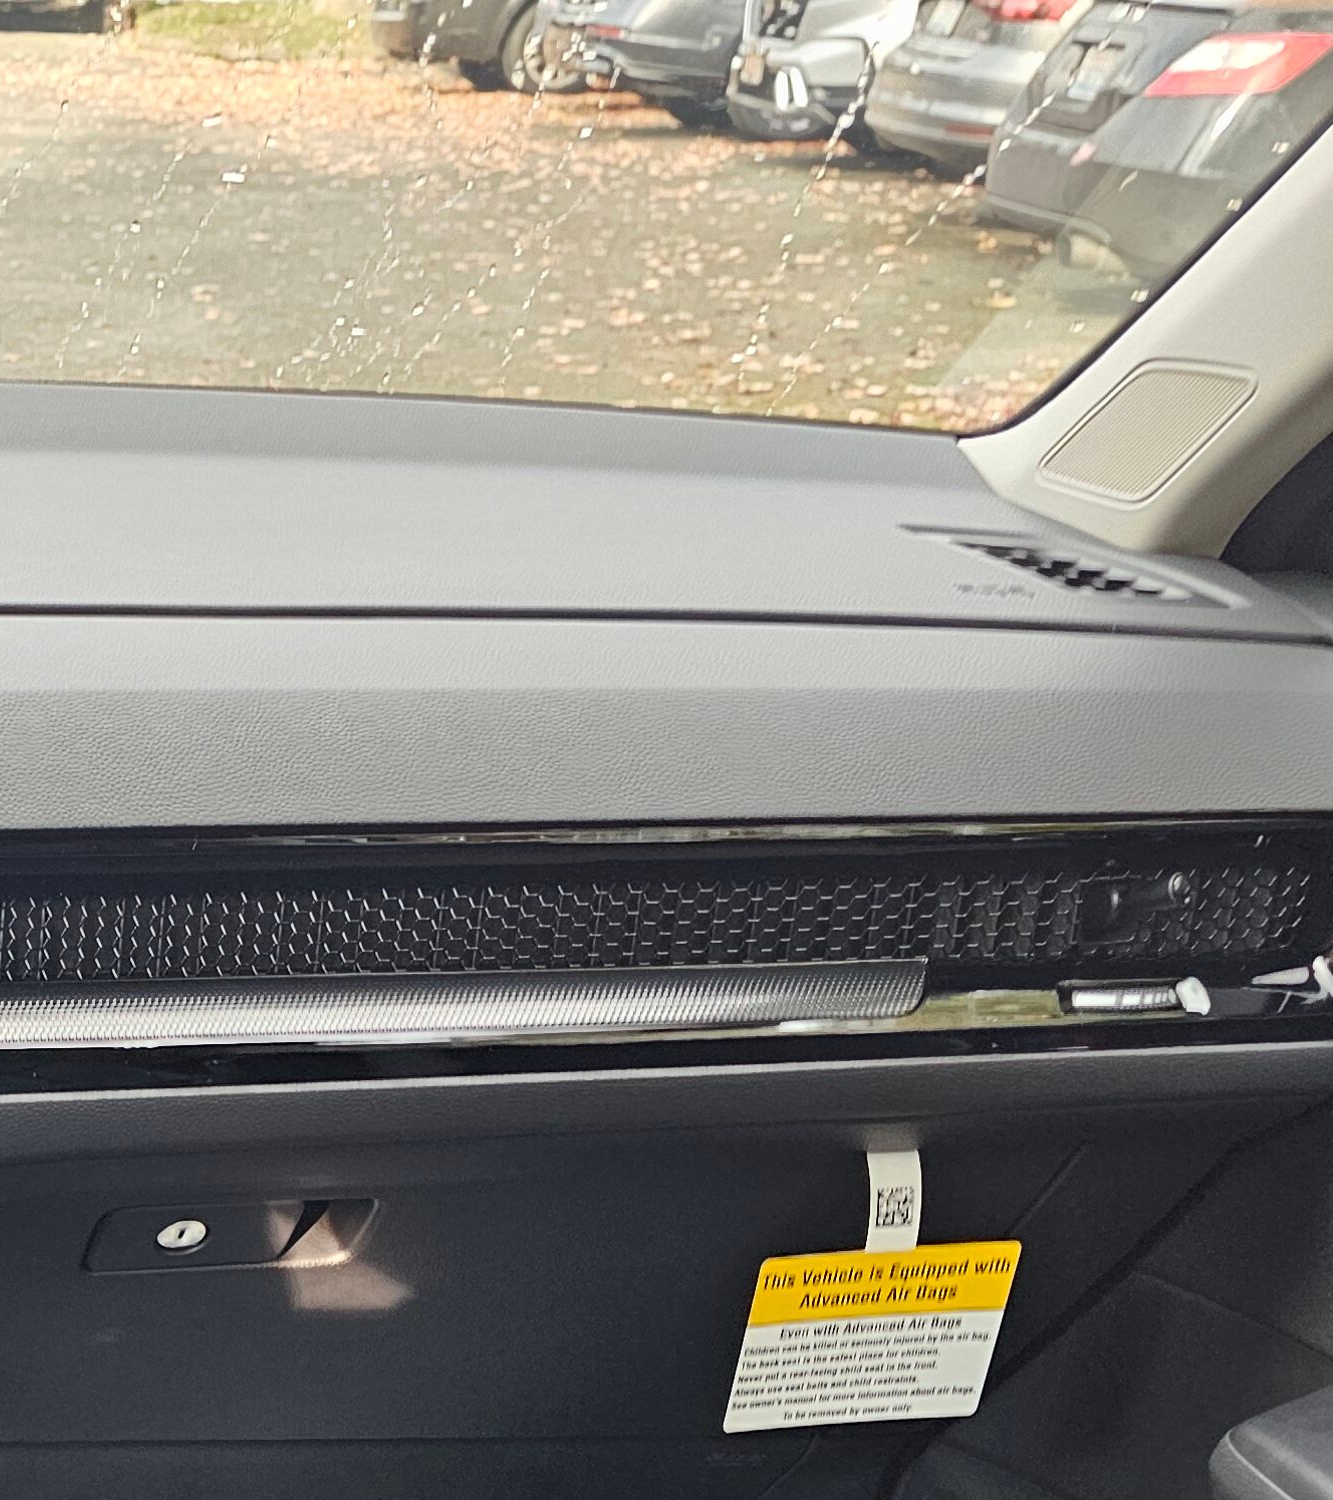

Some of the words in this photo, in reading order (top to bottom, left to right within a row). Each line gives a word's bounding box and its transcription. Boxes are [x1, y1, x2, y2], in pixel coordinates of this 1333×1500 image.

[763, 1271, 795, 1290] This
[802, 1267, 863, 1285] Vehicle
[869, 1264, 883, 1280] is
[889, 1258, 969, 1283] Equipped
[974, 1257, 1012, 1273] with
[799, 1290, 881, 1309] Advanced
[885, 1285, 910, 1302] Air
[916, 1284, 958, 1303] Bags
[779, 1328, 810, 1339] Even
[813, 1324, 840, 1336] with
[843, 1319, 905, 1335] Advanced
[908, 1318, 927, 1329] Air
[931, 1317, 962, 1330] Bags
[744, 1346, 780, 1357] Children
[851, 1337, 891, 1347] seriously
[893, 1334, 925, 1345] injured
[901, 1347, 940, 1357] children.
[734, 1388, 766, 1398] Always
[873, 1375, 920, 1386] restraints.
